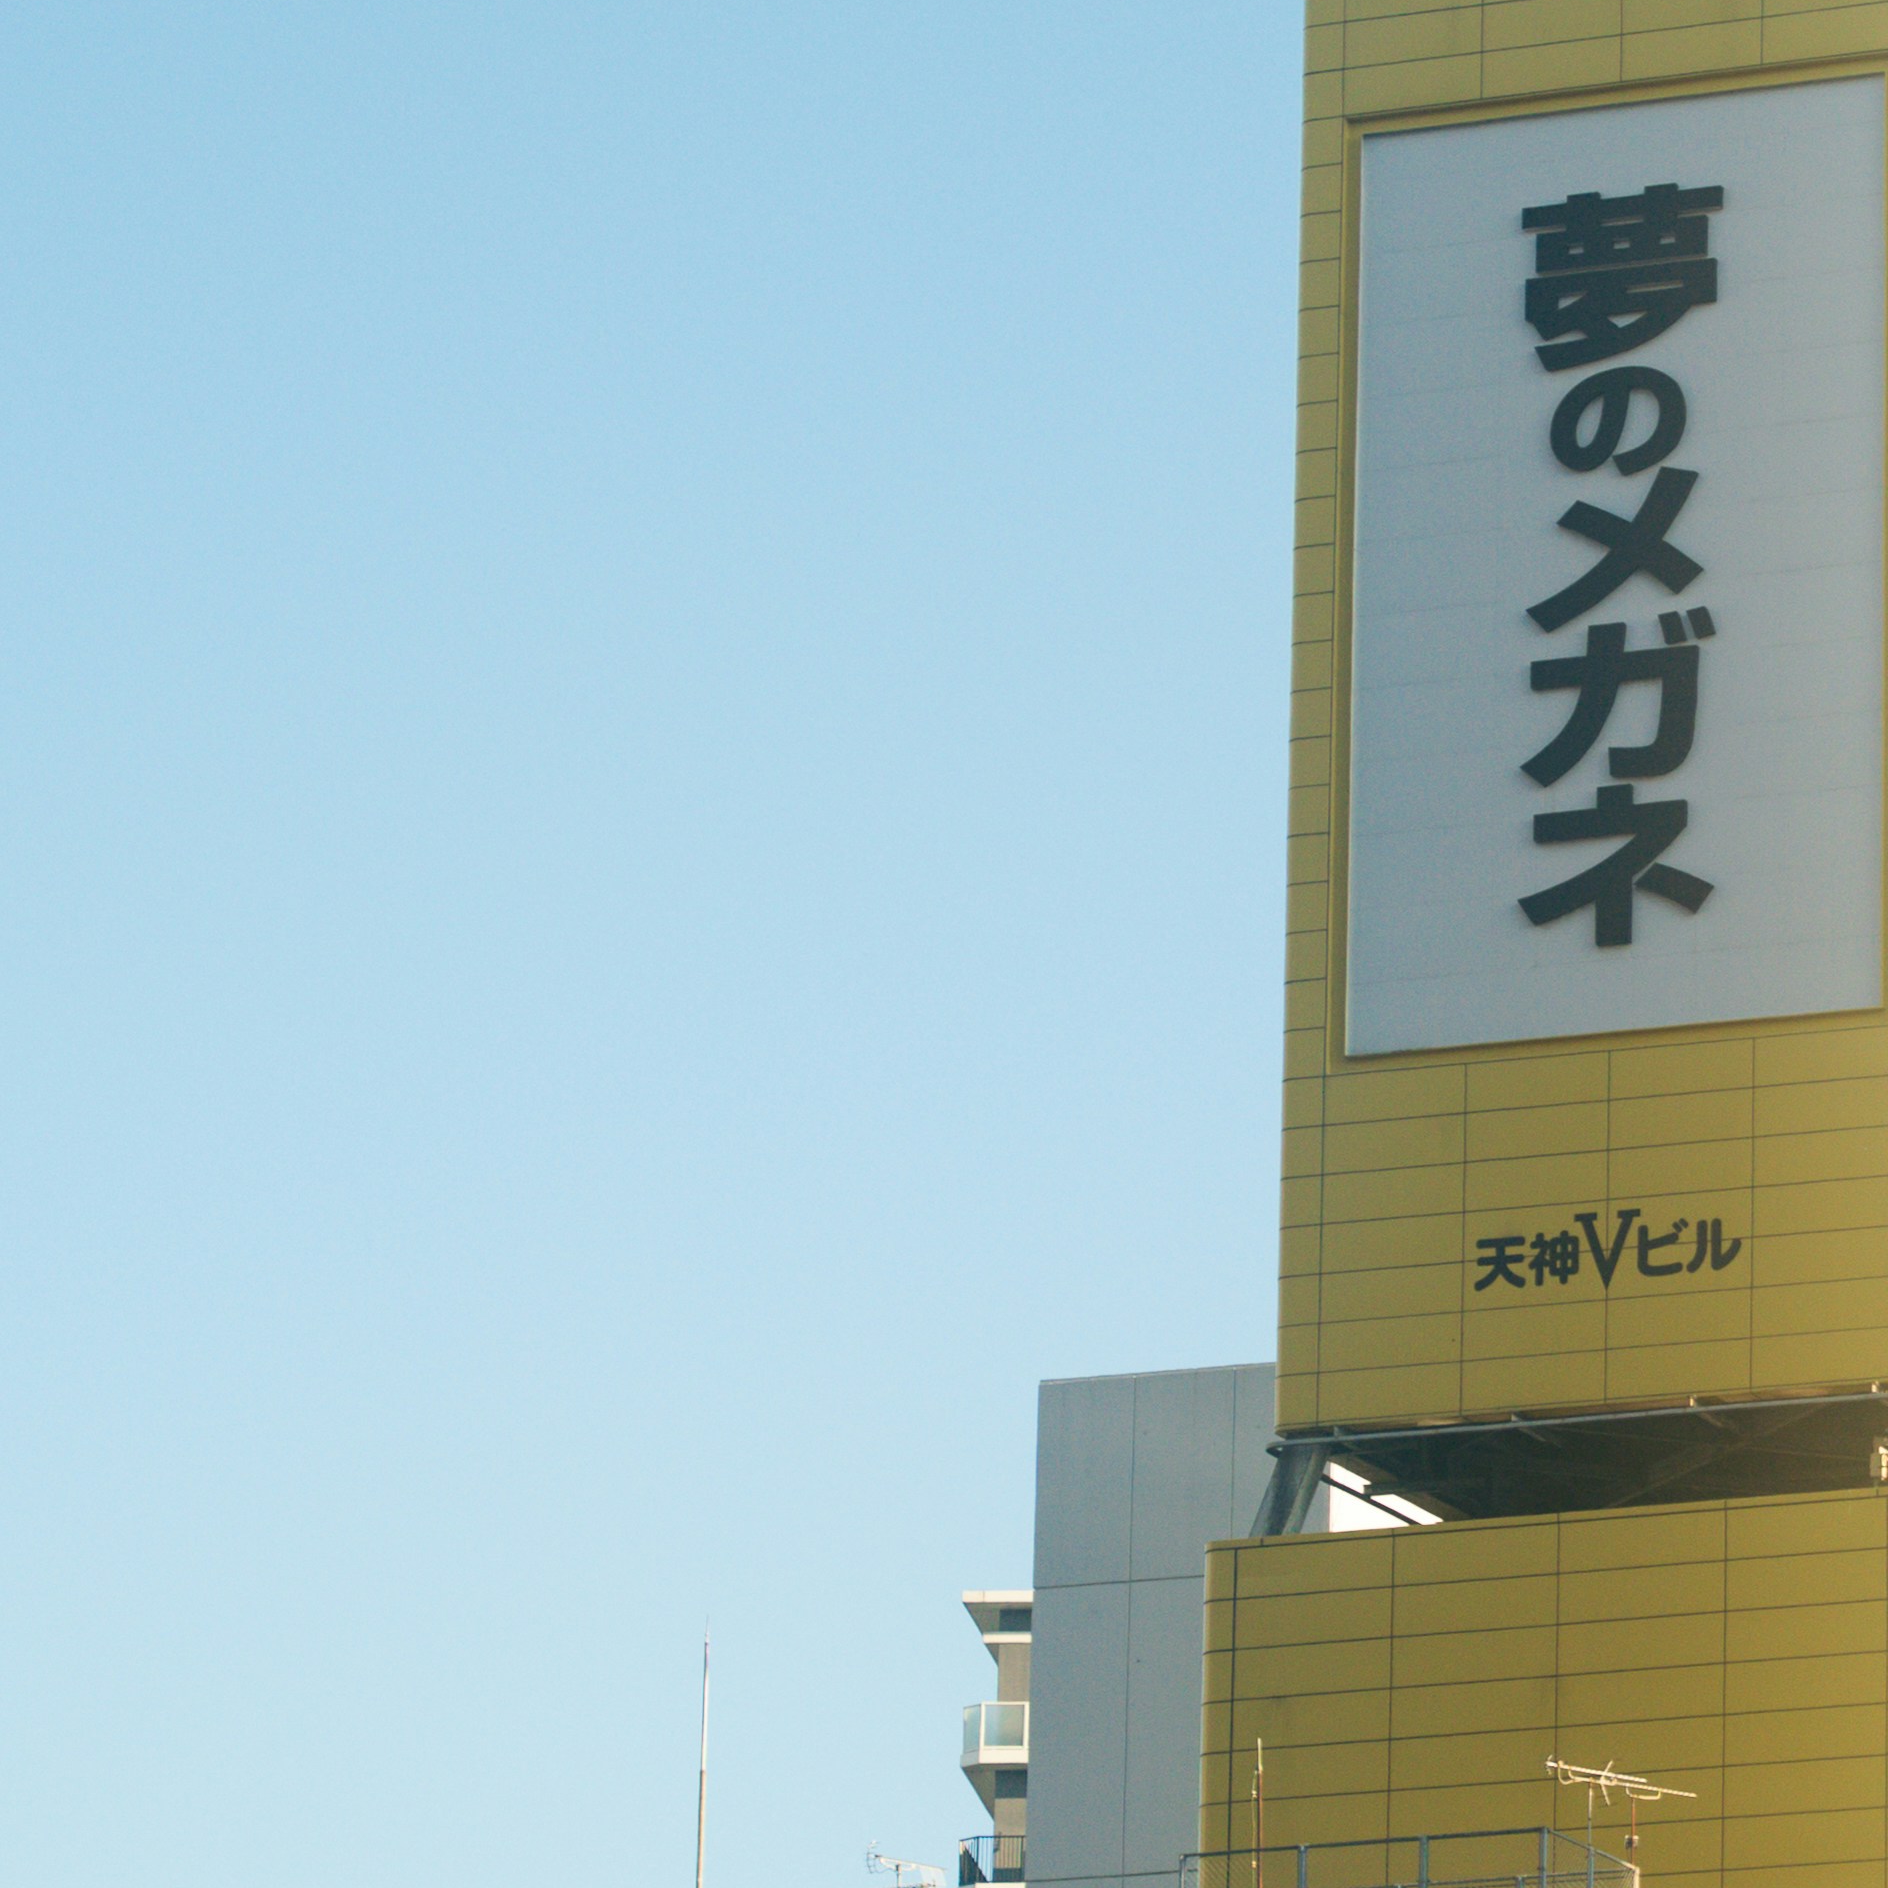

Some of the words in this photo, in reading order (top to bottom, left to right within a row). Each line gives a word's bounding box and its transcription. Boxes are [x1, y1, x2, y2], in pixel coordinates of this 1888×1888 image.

[1518, 181, 1727, 948] 夢のメガネ
[1473, 1206, 1743, 1292] 天神Vビル
